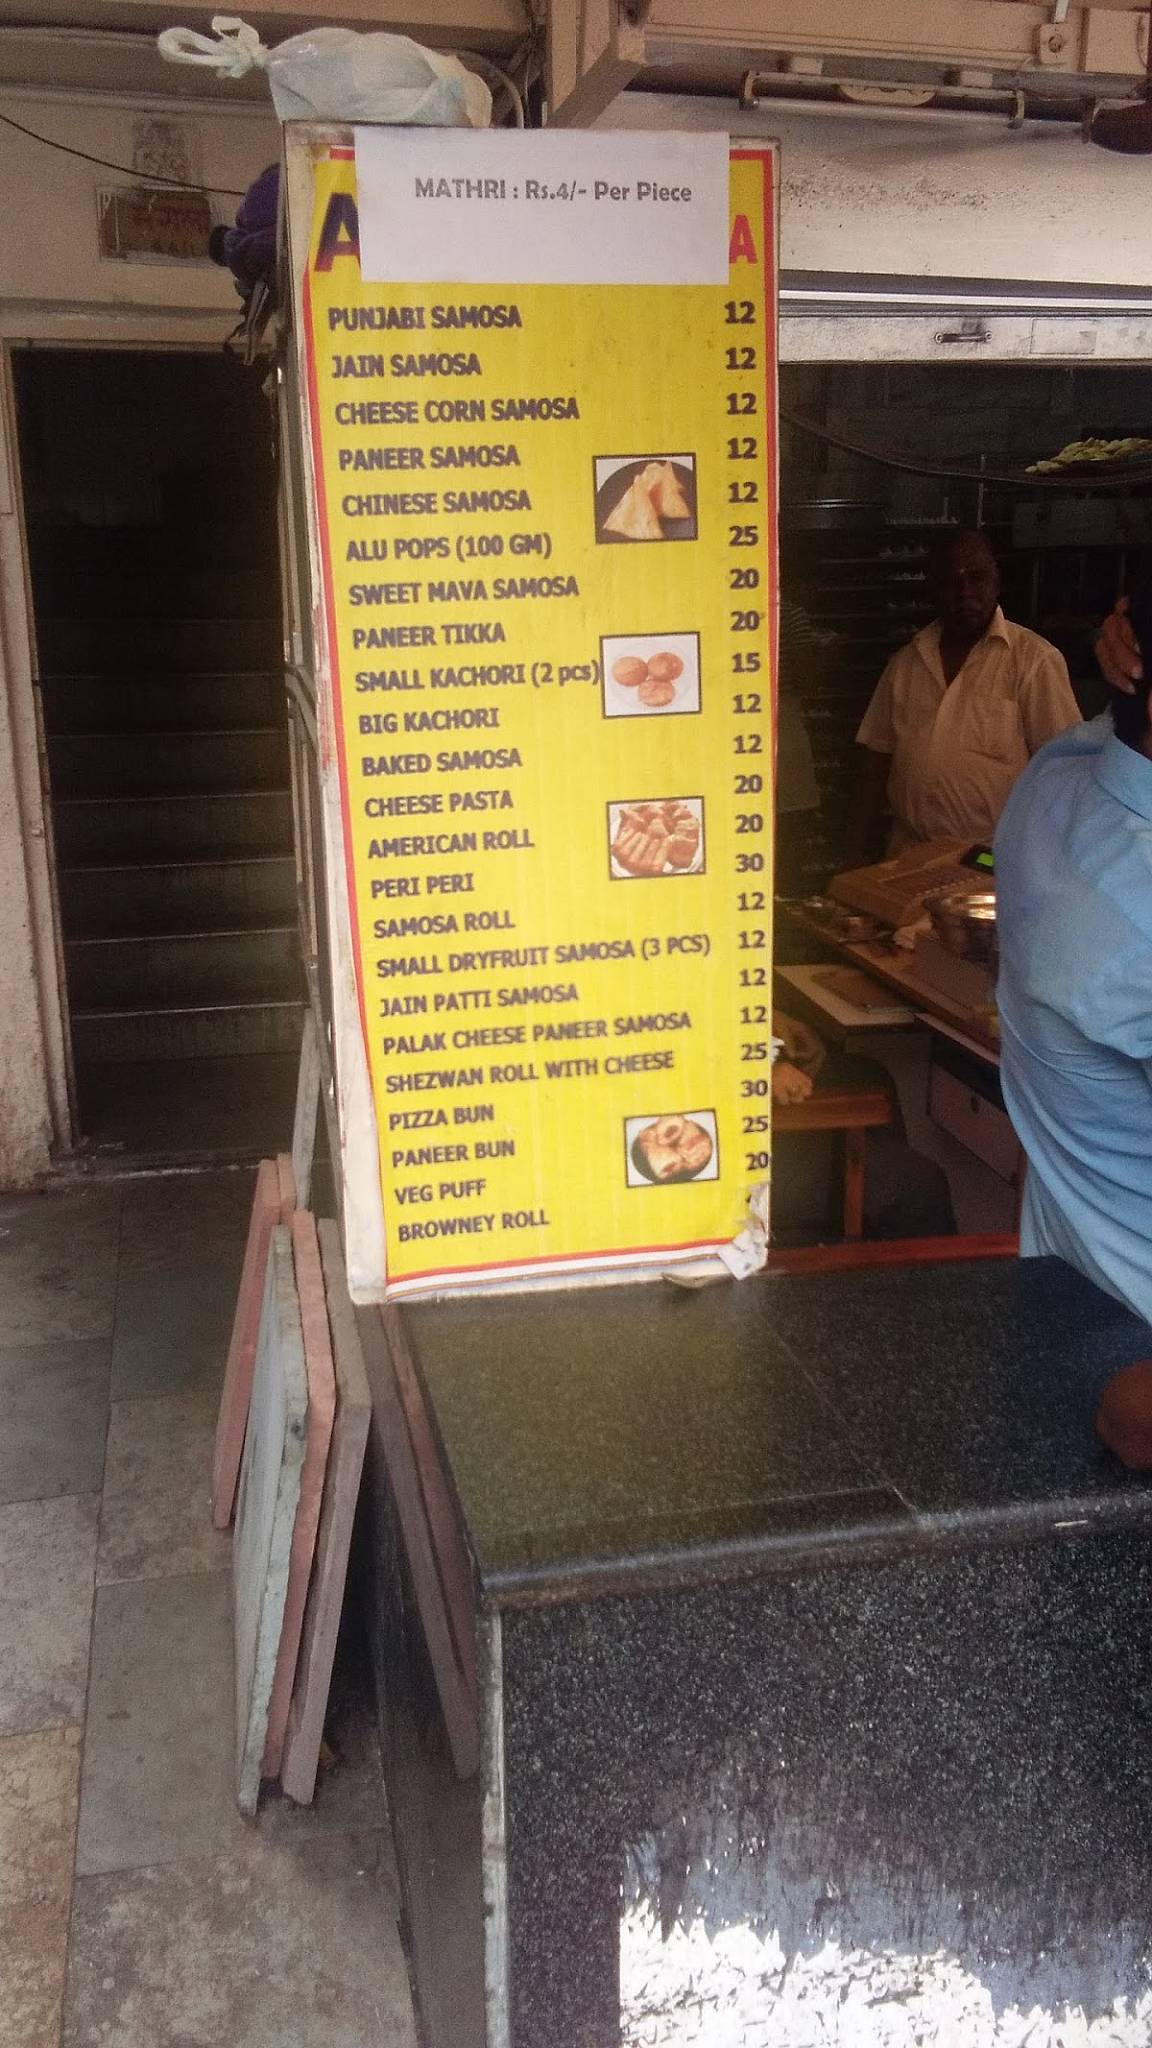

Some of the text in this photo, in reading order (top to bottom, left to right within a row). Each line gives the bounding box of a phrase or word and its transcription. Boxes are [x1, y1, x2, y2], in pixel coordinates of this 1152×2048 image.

[415, 178, 505, 199] MATHRI
[526, 180, 586, 201] Rs.4/-
[595, 181, 630, 200] Per
[637, 182, 691, 202] Piece
[328, 305, 522, 331] PUNJABI SAMOSA
[724, 301, 755, 324] 12
[332, 353, 482, 378] JAIN SAMOSA
[726, 347, 756, 370] 12
[335, 397, 580, 425] CHEESE CORN SAMOSA
[727, 393, 757, 415] 12
[339, 445, 520, 471] PANEER SAMOSA
[728, 437, 758, 459] 12
[342, 489, 532, 517] CHINESE SAMOSA
[728, 482, 758, 503] 12
[346, 532, 552, 562] ALU POPS (100 GM)
[729, 526, 759, 546] 25
[730, 568, 759, 589] 20
[349, 576, 579, 606] SWEET MAVA SAMOSA
[731, 610, 759, 631] 20
[353, 622, 506, 649] PANEER TIKKA
[732, 652, 761, 673] 15
[355, 658, 600, 692] SMALL KACHORI (2 pcs)
[733, 693, 762, 714] 12
[359, 708, 499, 734] BIG KACHORI
[734, 734, 762, 754] 12
[362, 748, 522, 776] BAKED SAMOSA
[735, 774, 763, 794] 20
[364, 790, 513, 818] CHEESE PASTA
[736, 814, 764, 833] 20
[368, 829, 535, 859] AMERICAN ROLL
[736, 853, 764, 873] 30
[371, 873, 474, 899] PERI PERI
[738, 892, 765, 911] 12
[374, 910, 516, 939] SAMOSA ROLL
[739, 930, 766, 949] 12
[376, 934, 710, 978] SMALL DRYFRUIT SAMOSA (3 PCS)
[740, 968, 767, 987] 12
[380, 984, 579, 1017] JAIN PATTI SAMOSA
[741, 1006, 767, 1024] 12
[384, 1012, 692, 1055] PALAK CHEESE PANEER SAMOSA
[741, 1042, 768, 1061] 25
[386, 1050, 674, 1093] SHEZWAN ROLL WITH CHEESE
[741, 1079, 768, 1097] 30
[389, 1104, 494, 1131] PIZZA BUN
[743, 1115, 768, 1133] 25
[392, 1140, 515, 1168] PANEER BUN
[745, 1152, 769, 1171] 20
[394, 1179, 486, 1205] VEG PUFF
[398, 1210, 550, 1242] BROWNEY ROLL
